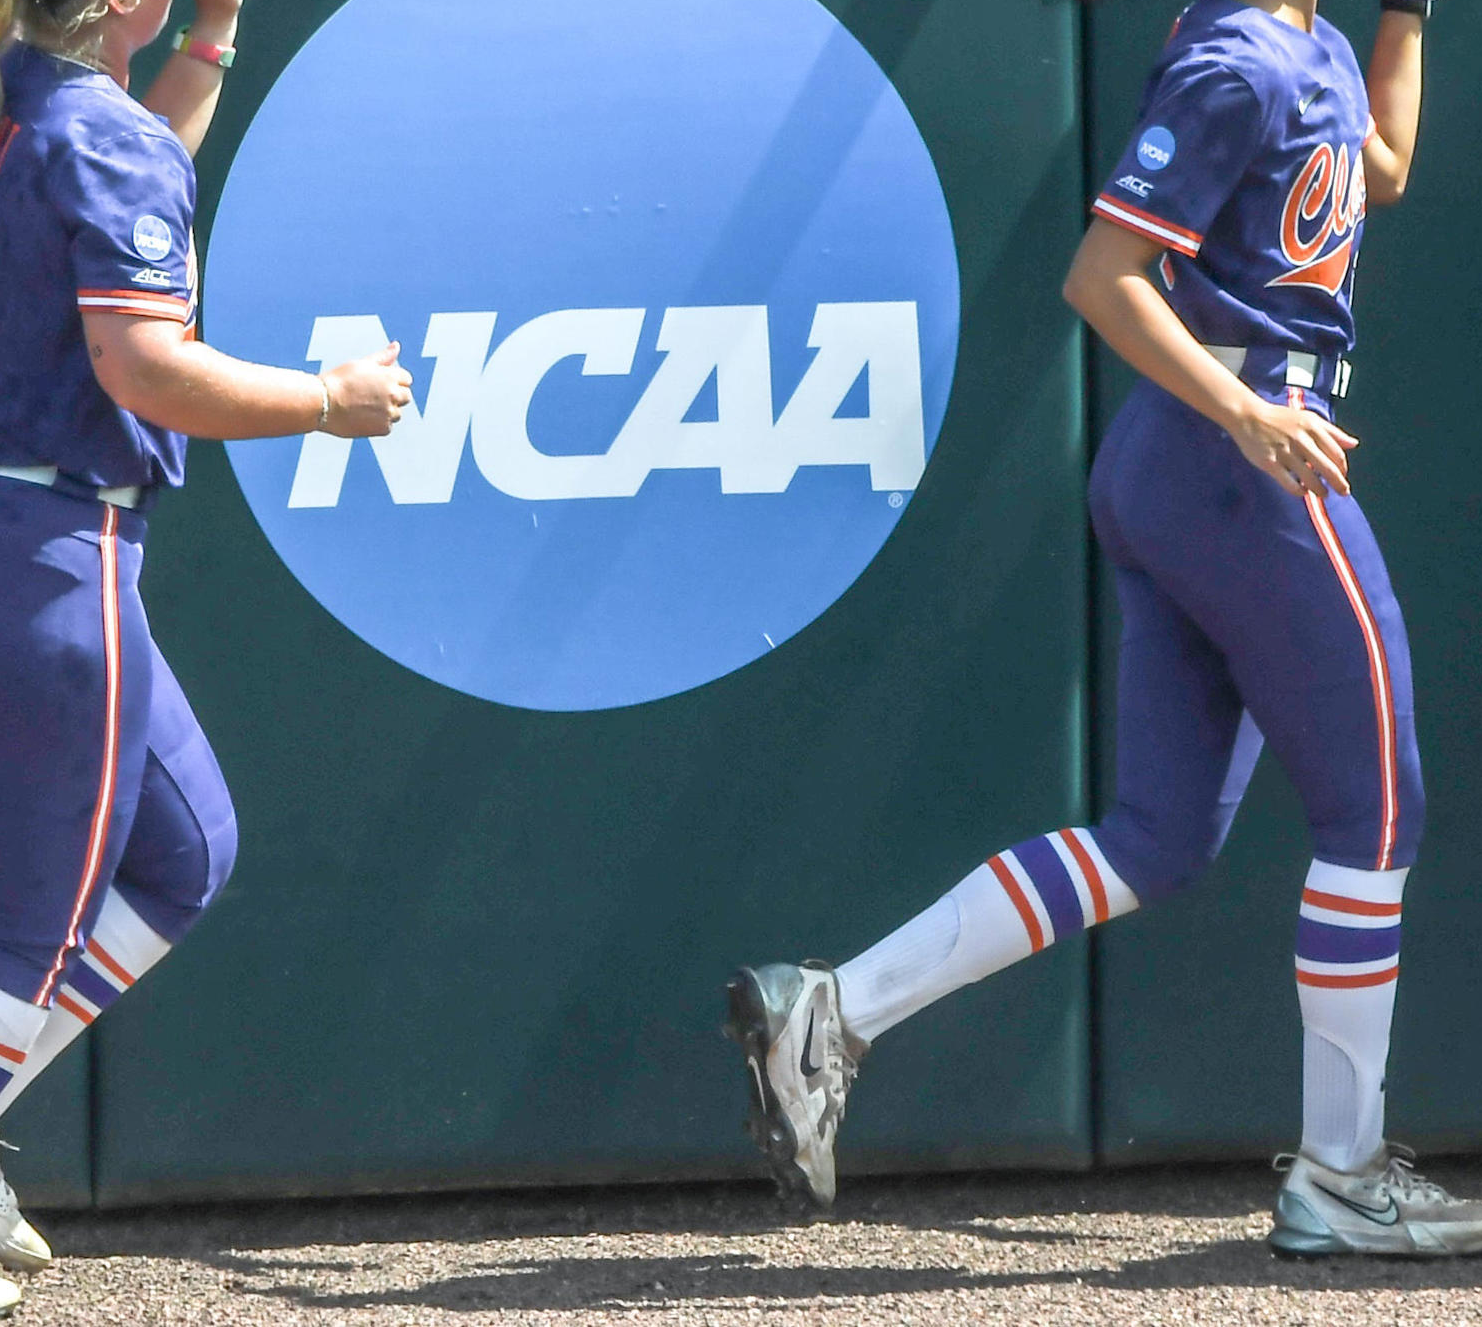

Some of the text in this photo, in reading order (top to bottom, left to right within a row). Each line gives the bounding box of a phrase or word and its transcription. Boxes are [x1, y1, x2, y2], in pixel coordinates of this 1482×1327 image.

[1115, 174, 1155, 198] ACC
[130, 268, 172, 287] ACC
[288, 301, 926, 509] NCAA
